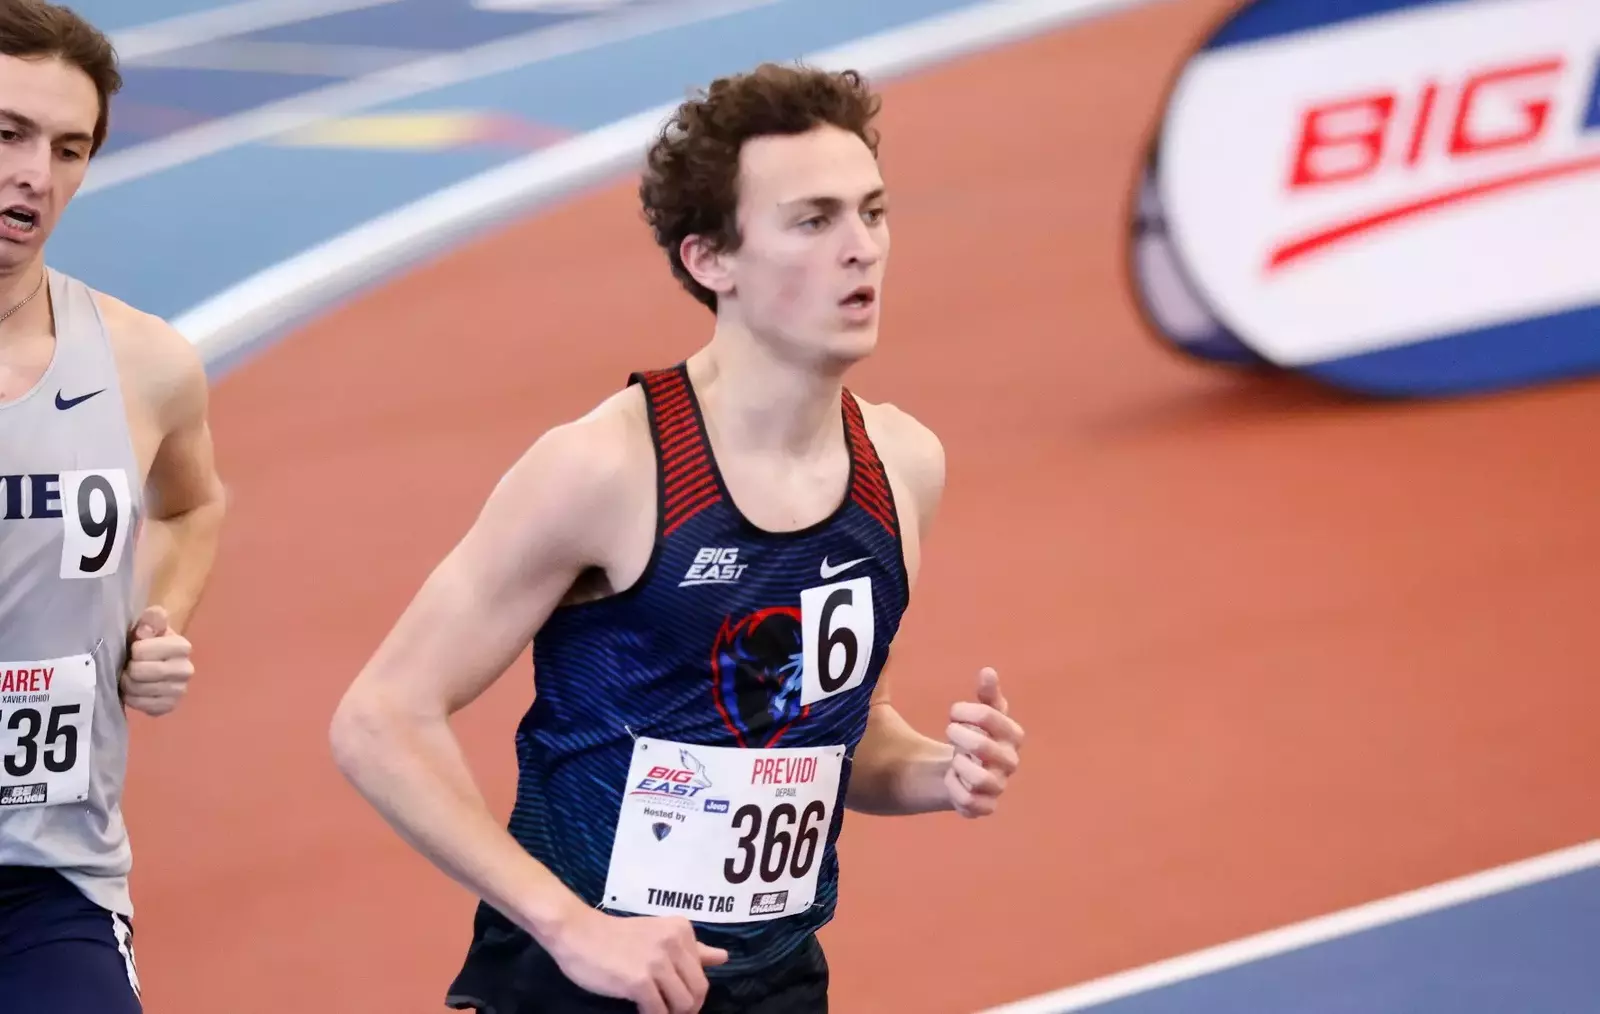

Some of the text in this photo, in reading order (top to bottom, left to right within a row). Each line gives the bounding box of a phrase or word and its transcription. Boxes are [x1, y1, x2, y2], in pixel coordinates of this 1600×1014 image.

[1288, 56, 1566, 191] BIG
[0, 474, 63, 520] IE
[77, 474, 118, 573] 9
[694, 547, 739, 565] BIG
[684, 563, 748, 580] EAST
[817, 588, 858, 693] 6
[0, 667, 54, 692] AREY
[2, 695, 27, 704] XAVIER
[0, 703, 81, 777] 35
[646, 766, 695, 784] BIG
[751, 756, 818, 785] PREVIDI
[636, 779, 705, 798] EAST
[643, 807, 687, 823] Hosted by
[706, 801, 728, 812] Jeep
[723, 800, 826, 884] 366
[647, 888, 703, 912] TIMING
[708, 895, 736, 914] TAG
